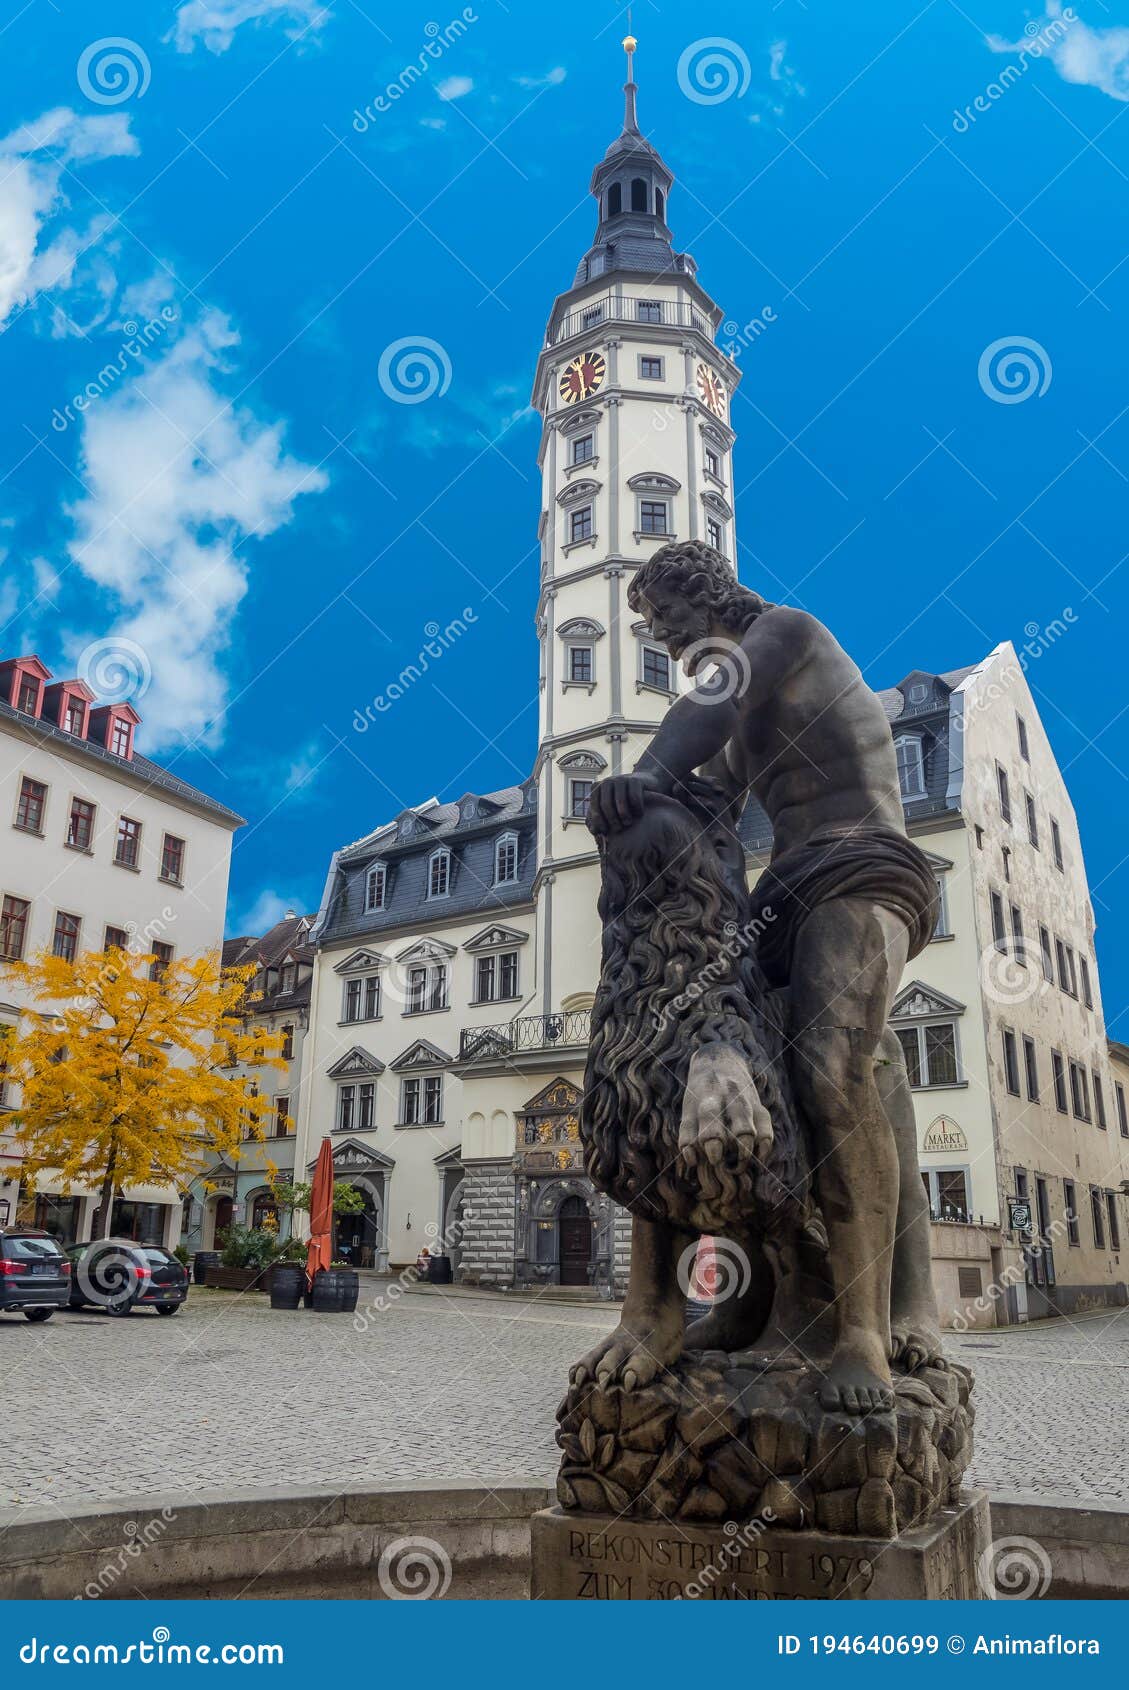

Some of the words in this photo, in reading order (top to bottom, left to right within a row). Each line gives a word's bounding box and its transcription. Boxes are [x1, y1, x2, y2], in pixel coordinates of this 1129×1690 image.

[928, 1133, 961, 1145] MARKT
[577, 1571, 632, 1600] ZUM
[808, 1552, 875, 1593] 1979
